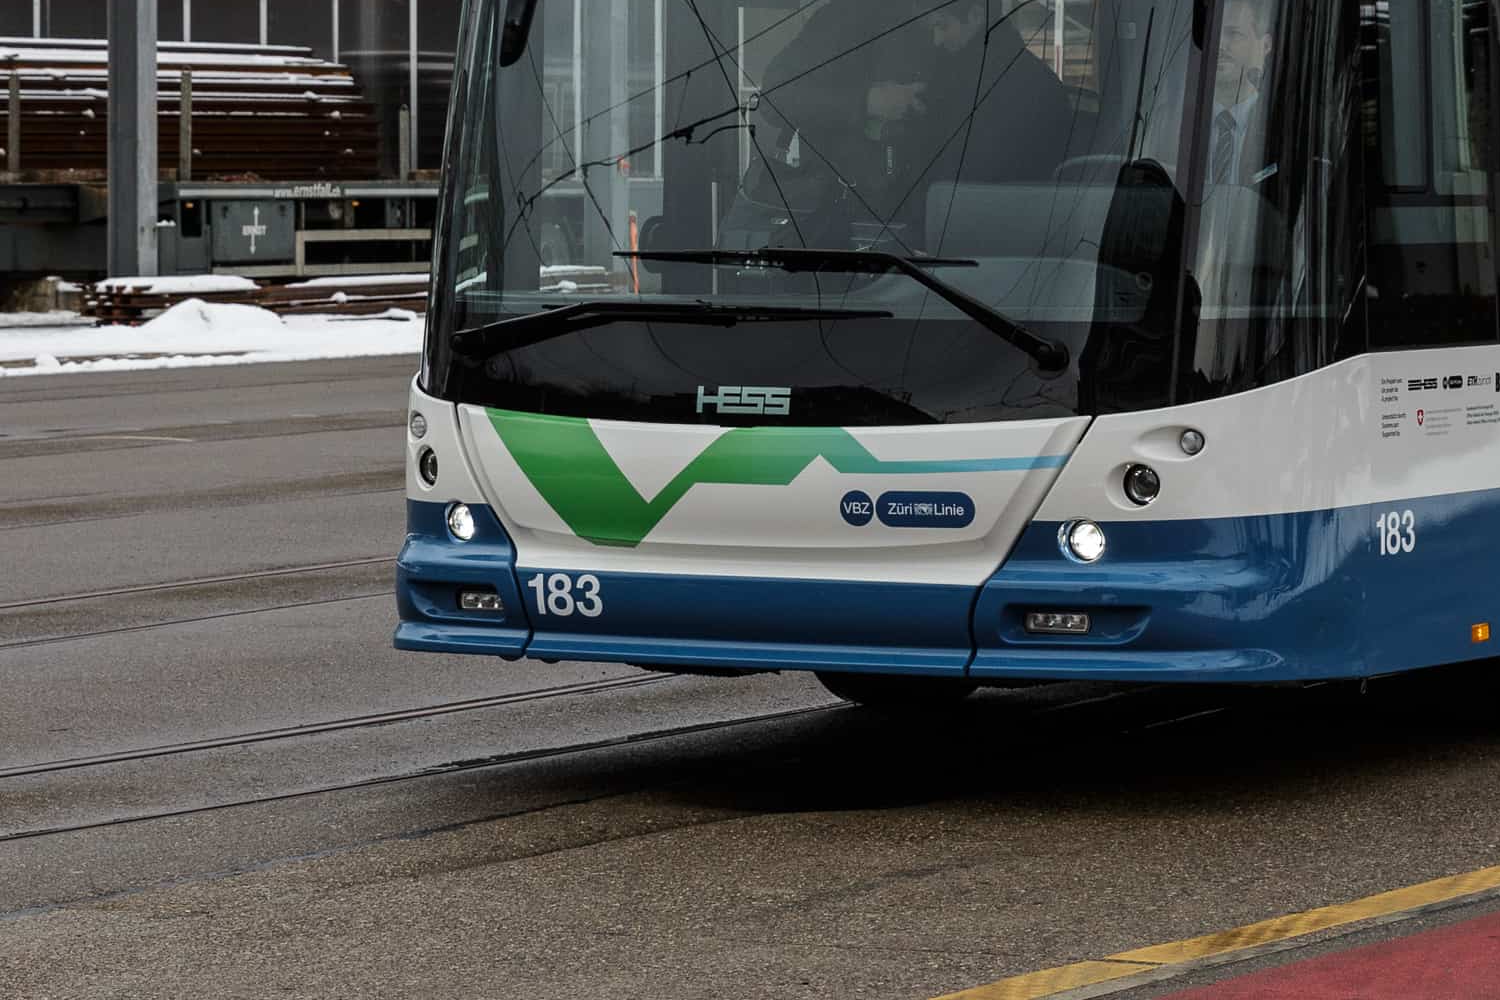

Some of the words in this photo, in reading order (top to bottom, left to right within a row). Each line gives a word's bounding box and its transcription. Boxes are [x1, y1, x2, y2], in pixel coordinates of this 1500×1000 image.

[696, 386, 791, 415] HESS
[843, 501, 870, 515] VBZ
[888, 502, 912, 516] Züri
[934, 502, 964, 517] Linie
[1376, 510, 1416, 556] 183
[528, 573, 603, 617] 183
